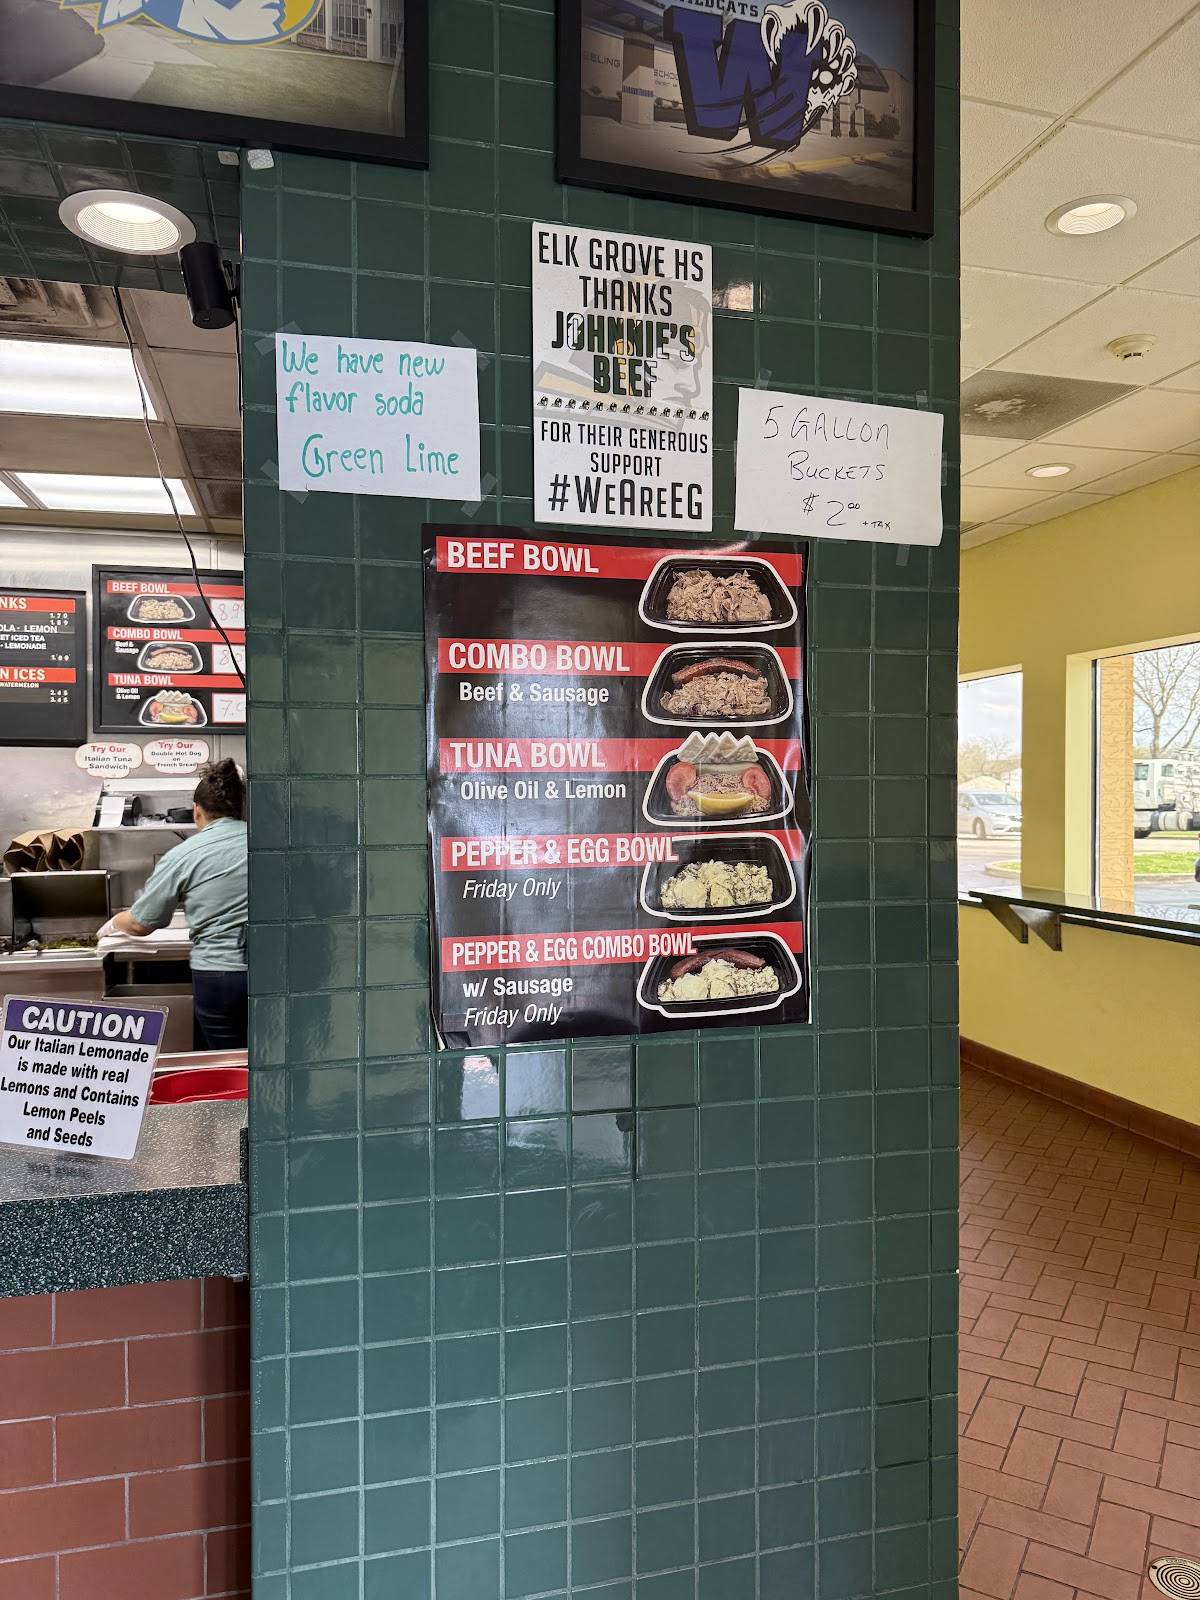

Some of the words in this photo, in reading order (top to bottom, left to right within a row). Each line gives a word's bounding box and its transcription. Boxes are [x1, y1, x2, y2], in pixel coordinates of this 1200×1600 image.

[538, 231, 580, 268] ELK
[589, 238, 666, 278] GROVE
[674, 248, 704, 282] HS
[579, 275, 672, 317] THANKS
[551, 310, 696, 362] JOHNNIE'S
[282, 340, 319, 375] We
[337, 344, 383, 374] have
[399, 352, 445, 377] new
[592, 355, 658, 398] BEEF
[285, 380, 357, 413] flavor
[375, 381, 424, 416] soda
[541, 420, 571, 443] FOR
[577, 423, 622, 447] THEIR
[629, 427, 708, 454] GENEROUS
[763, 405, 784, 439] 5
[790, 407, 889, 450] GALLON
[302, 433, 383, 477] Green
[406, 433, 459, 476] Lime
[590, 452, 662, 477] SUPPORT
[447, 541, 515, 569] BEEF
[523, 543, 600, 573] BOWL
[112, 582, 138, 592] BEEF
[140, 583, 170, 593] BOWL
[24, 625, 58, 633] LEMON
[113, 629, 150, 639] COMBO
[153, 630, 183, 640] BOWL
[448, 642, 547, 671] COMBO
[555, 644, 630, 672] BOWL
[13, 669, 46, 680] ICES
[113, 674, 141, 685] TUNA
[144, 675, 174, 685] BOWL
[459, 681, 504, 702] Beef
[510, 683, 524, 702] &
[529, 683, 610, 706] Sausage
[90, 745, 106, 753] Try
[109, 745, 126, 753] Our
[158, 741, 173, 750] Try
[176, 741, 194, 749] Our
[449, 741, 523, 768] TUNA
[530, 742, 606, 769] BOWL
[460, 781, 508, 801] Olive
[514, 781, 541, 800] Oil
[544, 781, 559, 800] &
[565, 781, 627, 800] Lemon
[451, 840, 538, 867] PEPPER
[544, 839, 561, 865] &
[567, 838, 610, 864] EGG
[616, 836, 679, 863] BOWL
[462, 878, 518, 901] Friday
[523, 877, 561, 899] Only
[452, 940, 520, 967] PEPPER
[525, 939, 539, 961] &
[543, 938, 577, 961] EGG
[582, 935, 645, 959] COMBO
[648, 932, 697, 957] BOWL
[462, 978, 488, 998] w/
[493, 976, 574, 998] Sausage
[22, 1005, 145, 1041] CAUTION
[464, 1007, 519, 1028] Friday
[524, 1003, 563, 1025] Only
[8, 1034, 31, 1051] Our
[34, 1037, 75, 1056] Italian
[78, 1042, 149, 1063] Lemonade
[17, 1056, 29, 1073] is
[32, 1060, 67, 1076] made
[71, 1063, 99, 1080] with
[102, 1068, 130, 1083] real
[0, 1076, 50, 1096] Lemons
[53, 1085, 78, 1100] and
[81, 1086, 140, 1107] Contains
[23, 1101, 66, 1121] Lemon
[69, 1106, 106, 1126] Peels
[26, 1126, 51, 1142] and
[54, 1127, 93, 1147] Seeds
